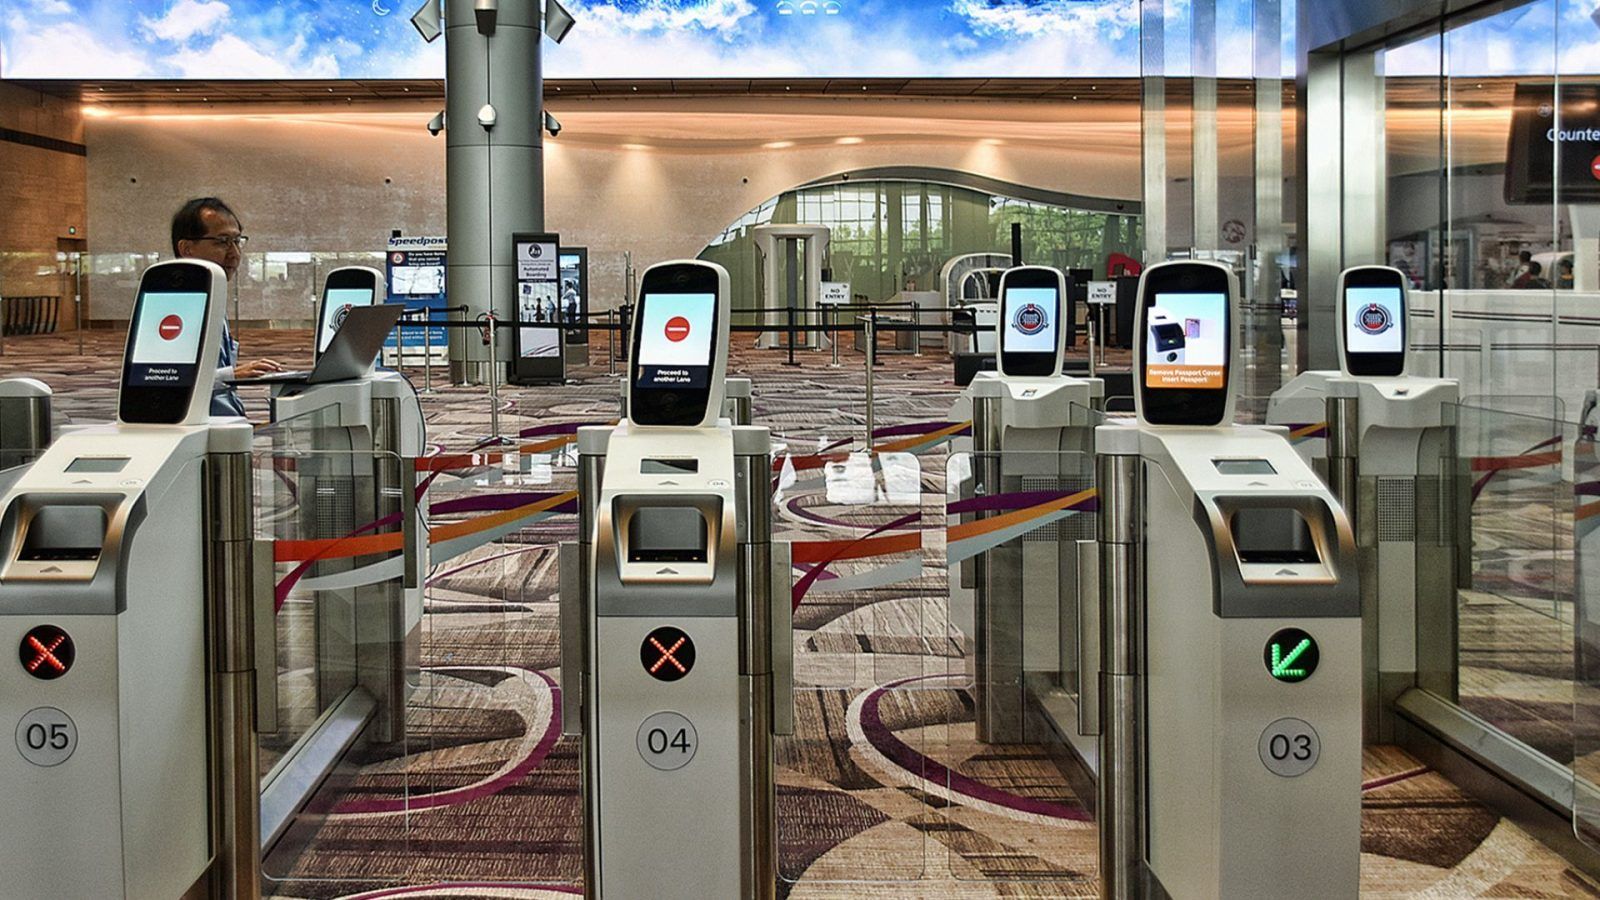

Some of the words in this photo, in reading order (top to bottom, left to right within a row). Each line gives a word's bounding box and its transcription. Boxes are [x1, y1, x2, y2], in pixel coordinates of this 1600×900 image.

[1546, 128, 1600, 142] Counte
[388, 236, 448, 247] Speedpost
[1174, 369, 1201, 377] Passport
[1180, 376, 1208, 384] Passport
[27, 723, 69, 750] 05
[648, 728, 691, 754] 04
[1270, 734, 1312, 760] 03
